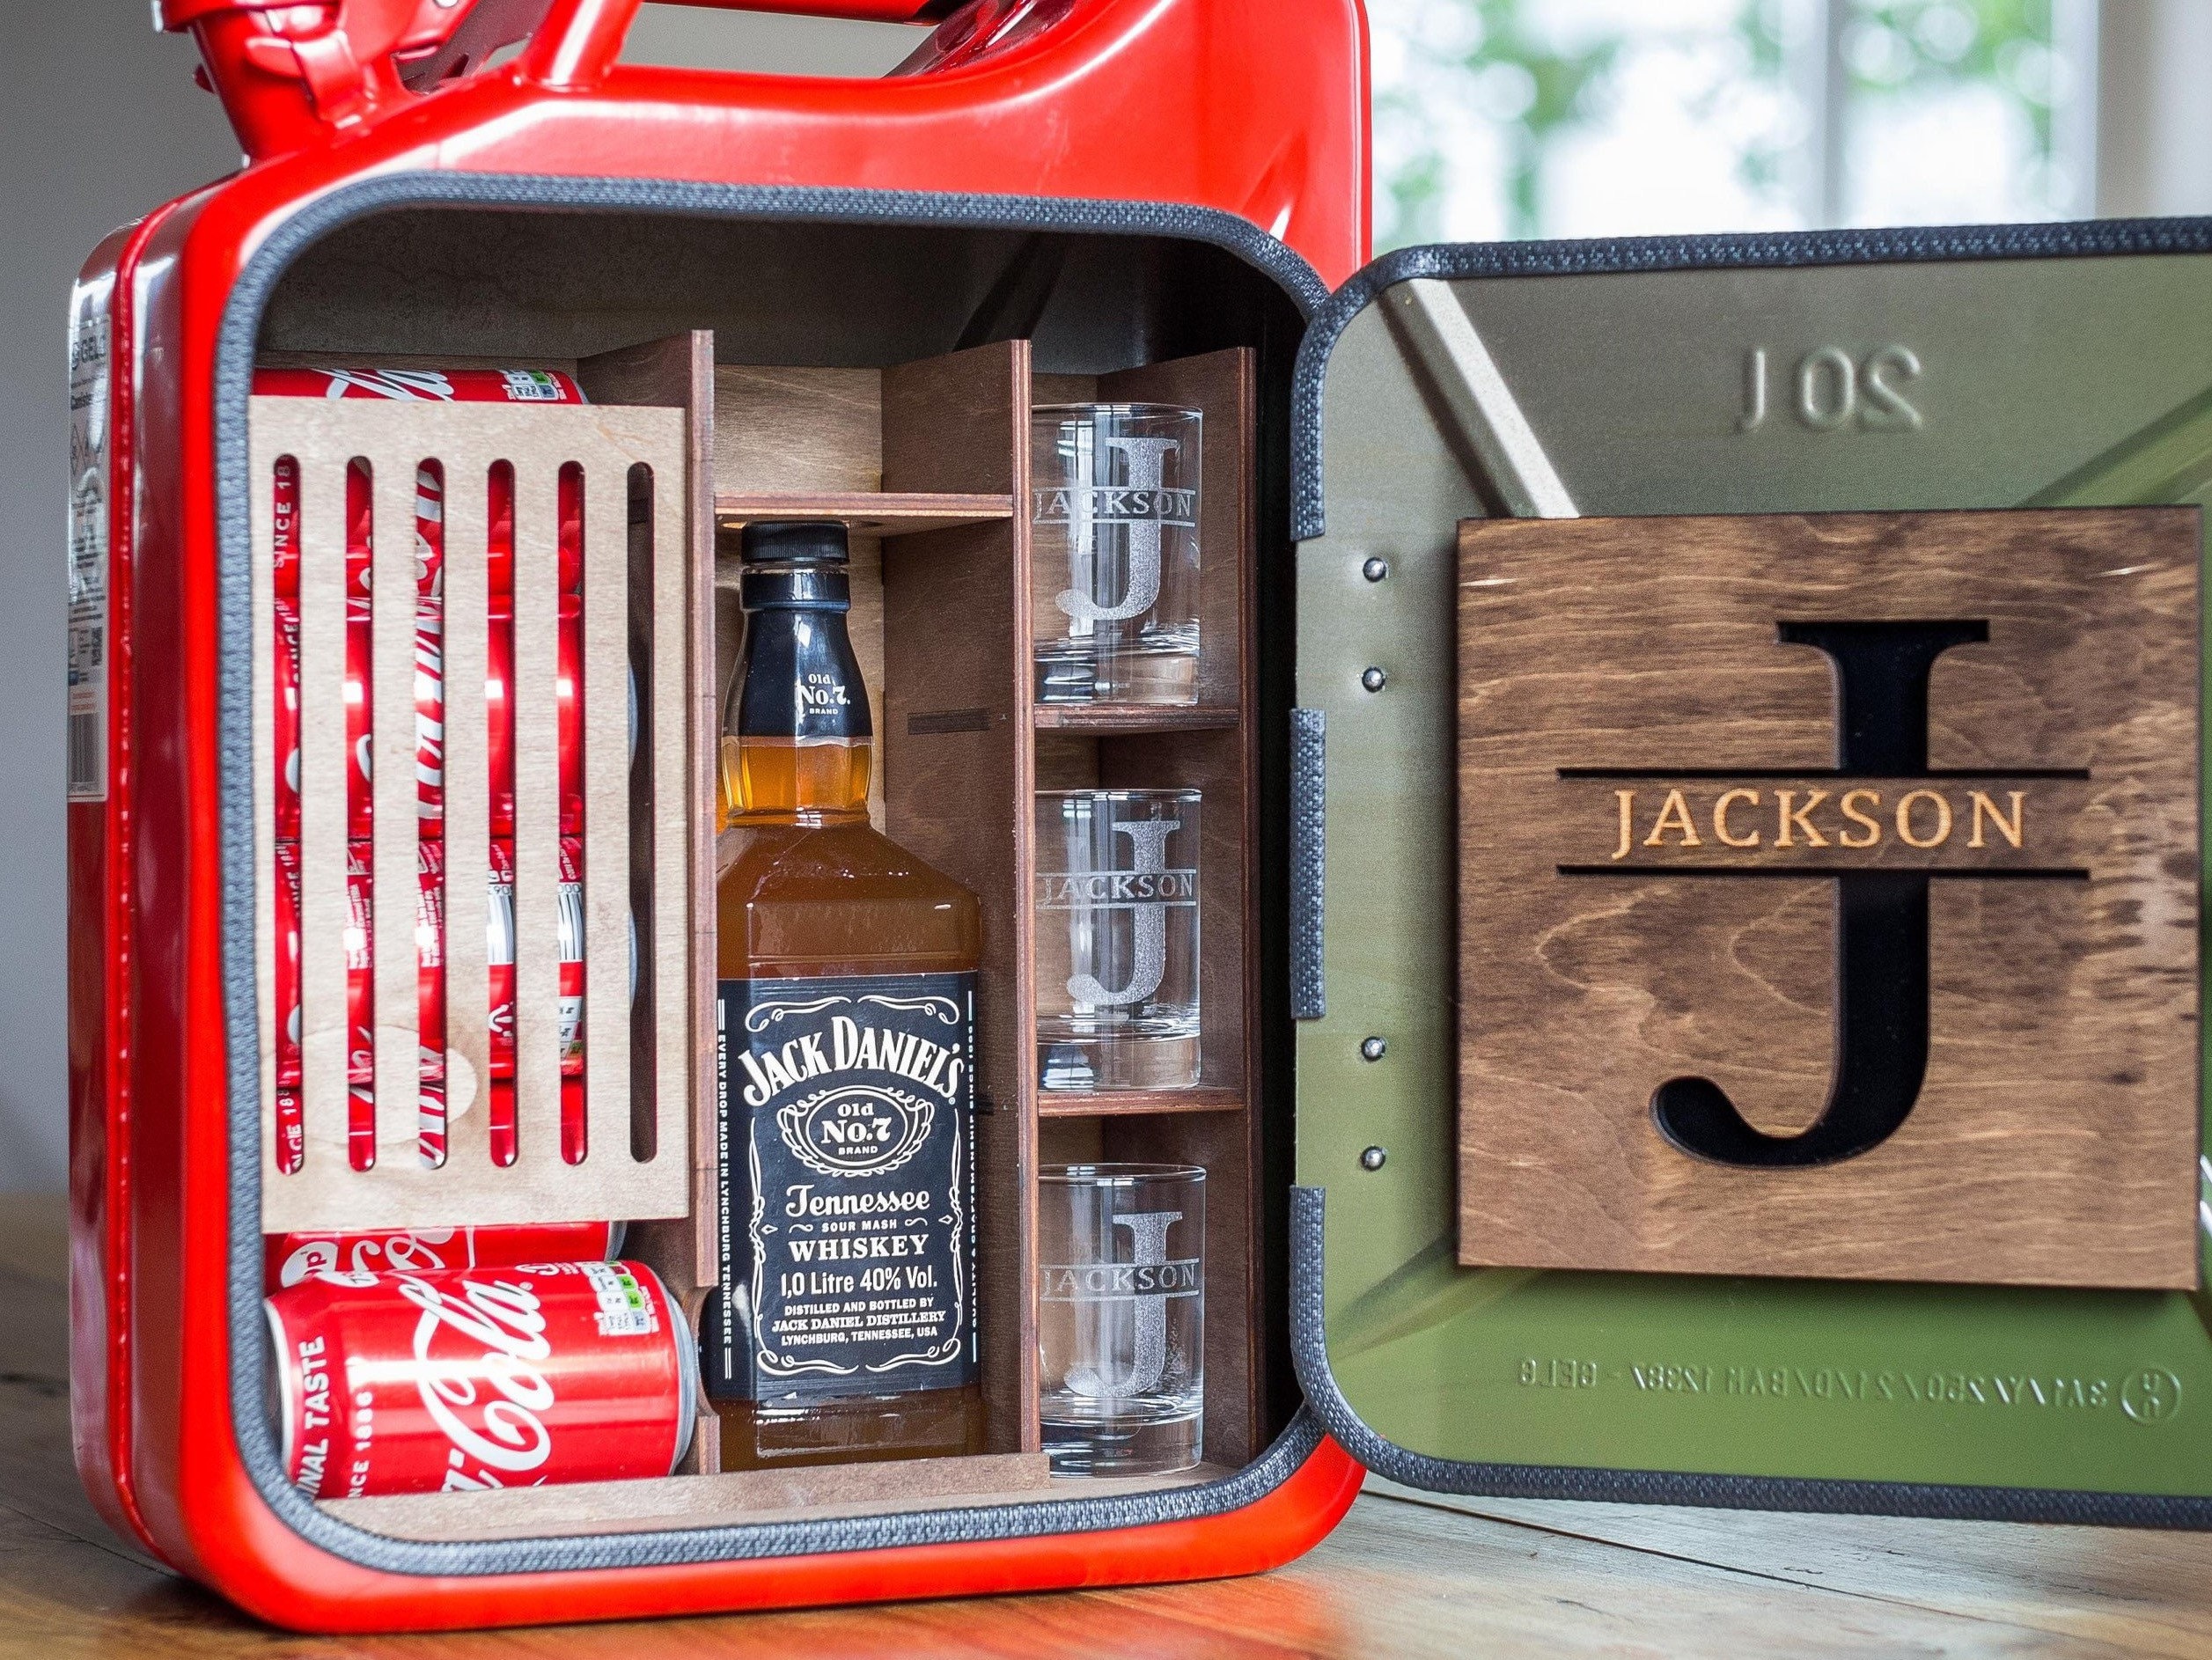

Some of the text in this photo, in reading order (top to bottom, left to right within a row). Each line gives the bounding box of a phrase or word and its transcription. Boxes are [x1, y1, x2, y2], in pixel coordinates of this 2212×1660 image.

[1033, 489, 1192, 522] JACKSON
[1055, 437, 1179, 621] J
[808, 673, 830, 685] Old
[809, 707, 839, 716] BRAND
[1611, 786, 2026, 861] JACKSON
[1037, 873, 1194, 908] JACKSON
[1649, 618, 1990, 1169] J
[1067, 819, 1180, 1005] J
[738, 1015, 966, 1107] JACK DANIEL'S
[837, 1102, 875, 1118] Old
[838, 1145, 878, 1156] BRAND
[717, 1034, 732, 1344] EVERY DROP MADE IN LYNCHBURG TENNESSEE
[785, 1184, 931, 1218] Tennessee
[821, 1218, 898, 1233] SOUR MASH
[788, 1233, 930, 1263] WHISKEY
[781, 1264, 938, 1299] 1,0 Litre 40% Vol.
[1040, 1263, 1195, 1297] JACKSON
[771, 1310, 947, 1333] JACK DANIEL DISTILLERY
[784, 1296, 935, 1317] DISTILLED AND BOTTLED BY
[1063, 1210, 1183, 1399] J
[781, 1326, 938, 1348] LYNCHBURG, TENNESSEE, USA
[298, 1334, 331, 1430] TASTE
[354, 1390, 374, 1451] 1886
